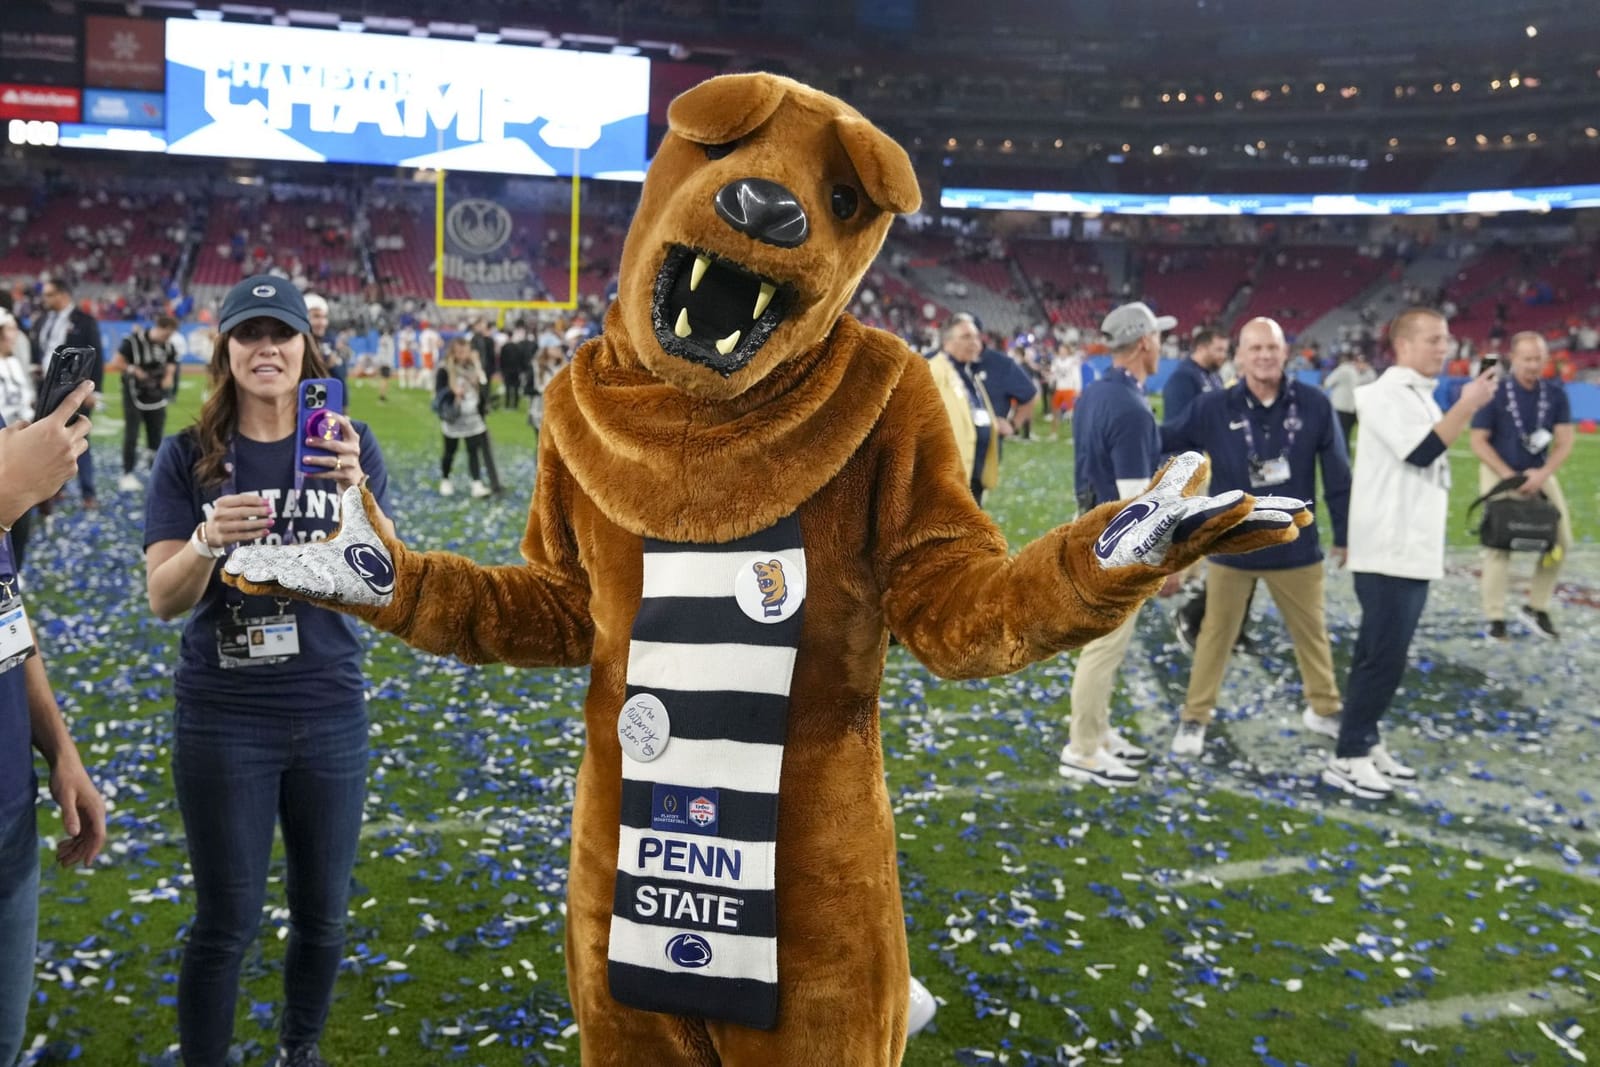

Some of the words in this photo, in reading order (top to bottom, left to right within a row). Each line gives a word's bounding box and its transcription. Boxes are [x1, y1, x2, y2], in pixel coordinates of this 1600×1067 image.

[428, 255, 530, 283] llstate
[638, 837, 743, 881] PENN
[635, 885, 738, 928] STATE
